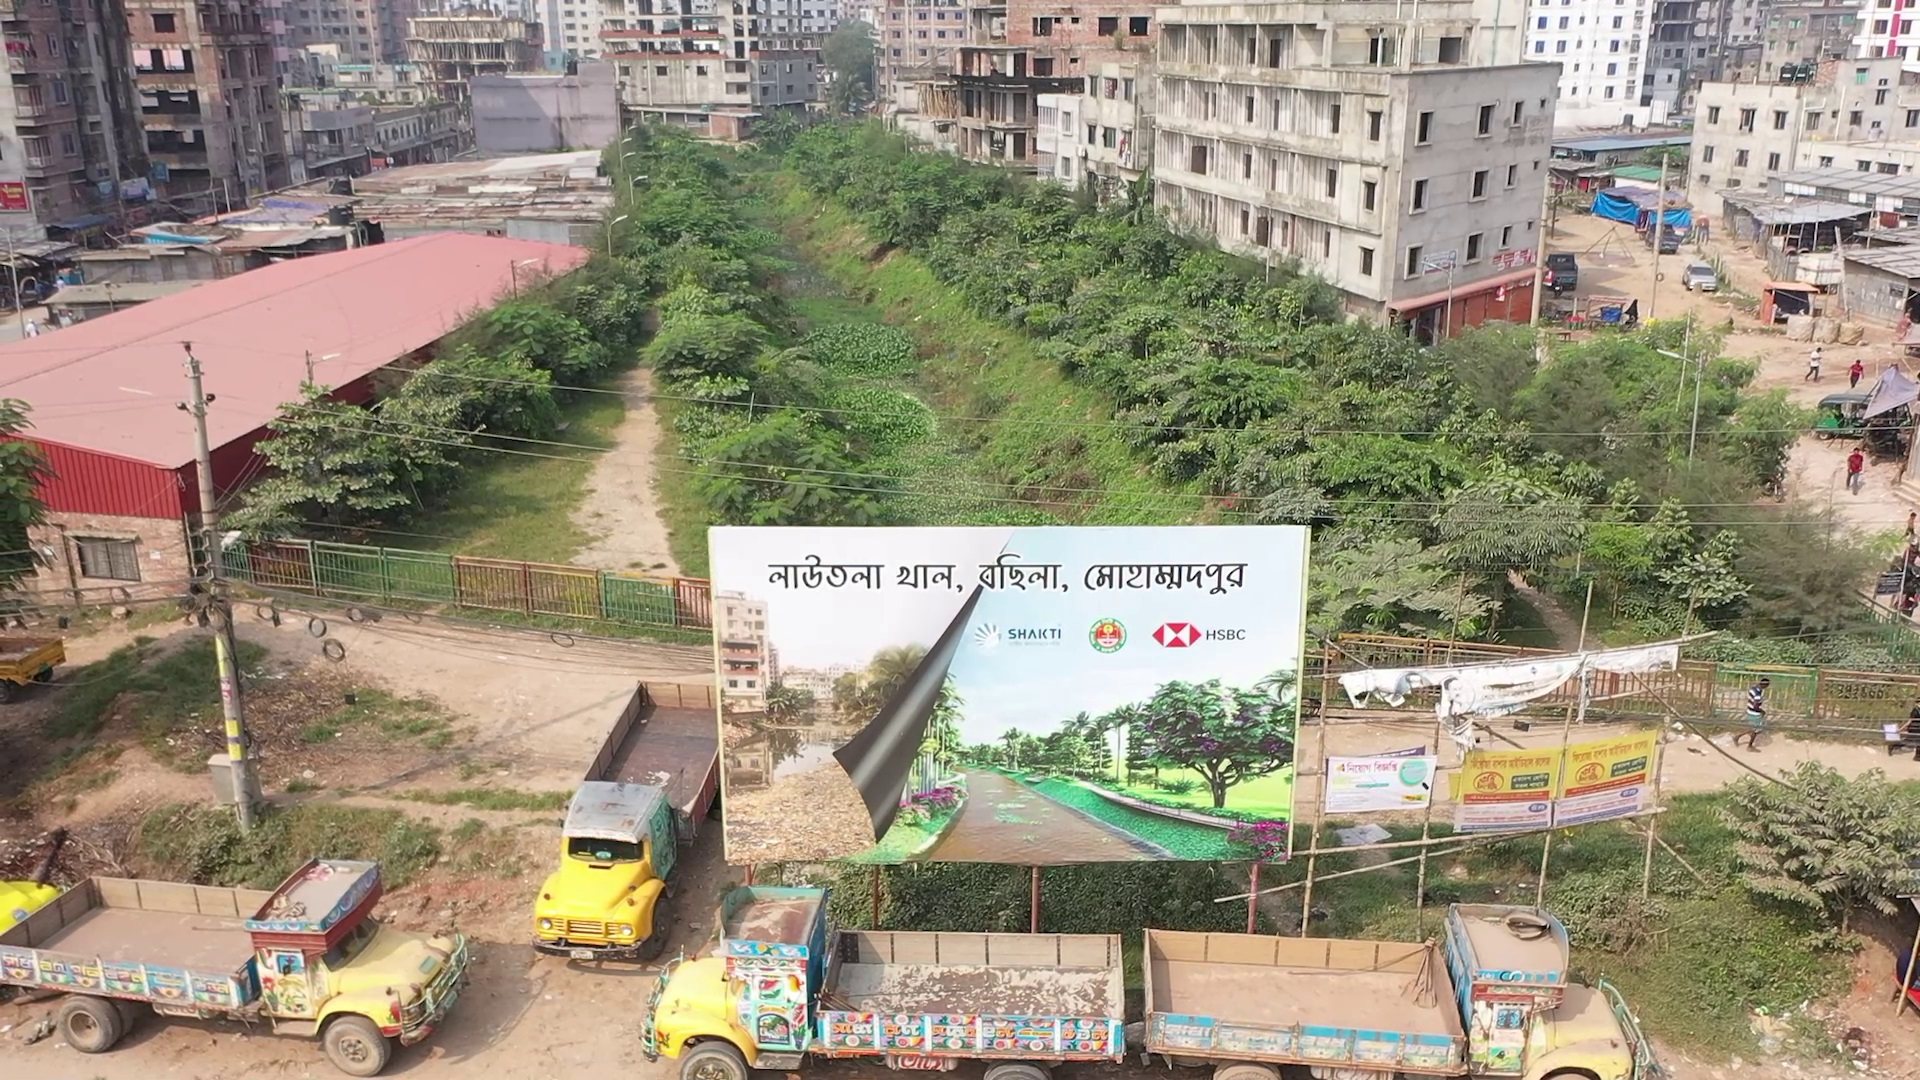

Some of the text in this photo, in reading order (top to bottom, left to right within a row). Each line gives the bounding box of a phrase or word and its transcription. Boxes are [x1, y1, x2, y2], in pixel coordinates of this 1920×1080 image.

[767, 553, 1248, 595] লাউতলা খাল, বছিলা, মোহাম্মদপুর
[1007, 628, 1062, 640] SHAKTI
[1205, 628, 1247, 641] HSBC
